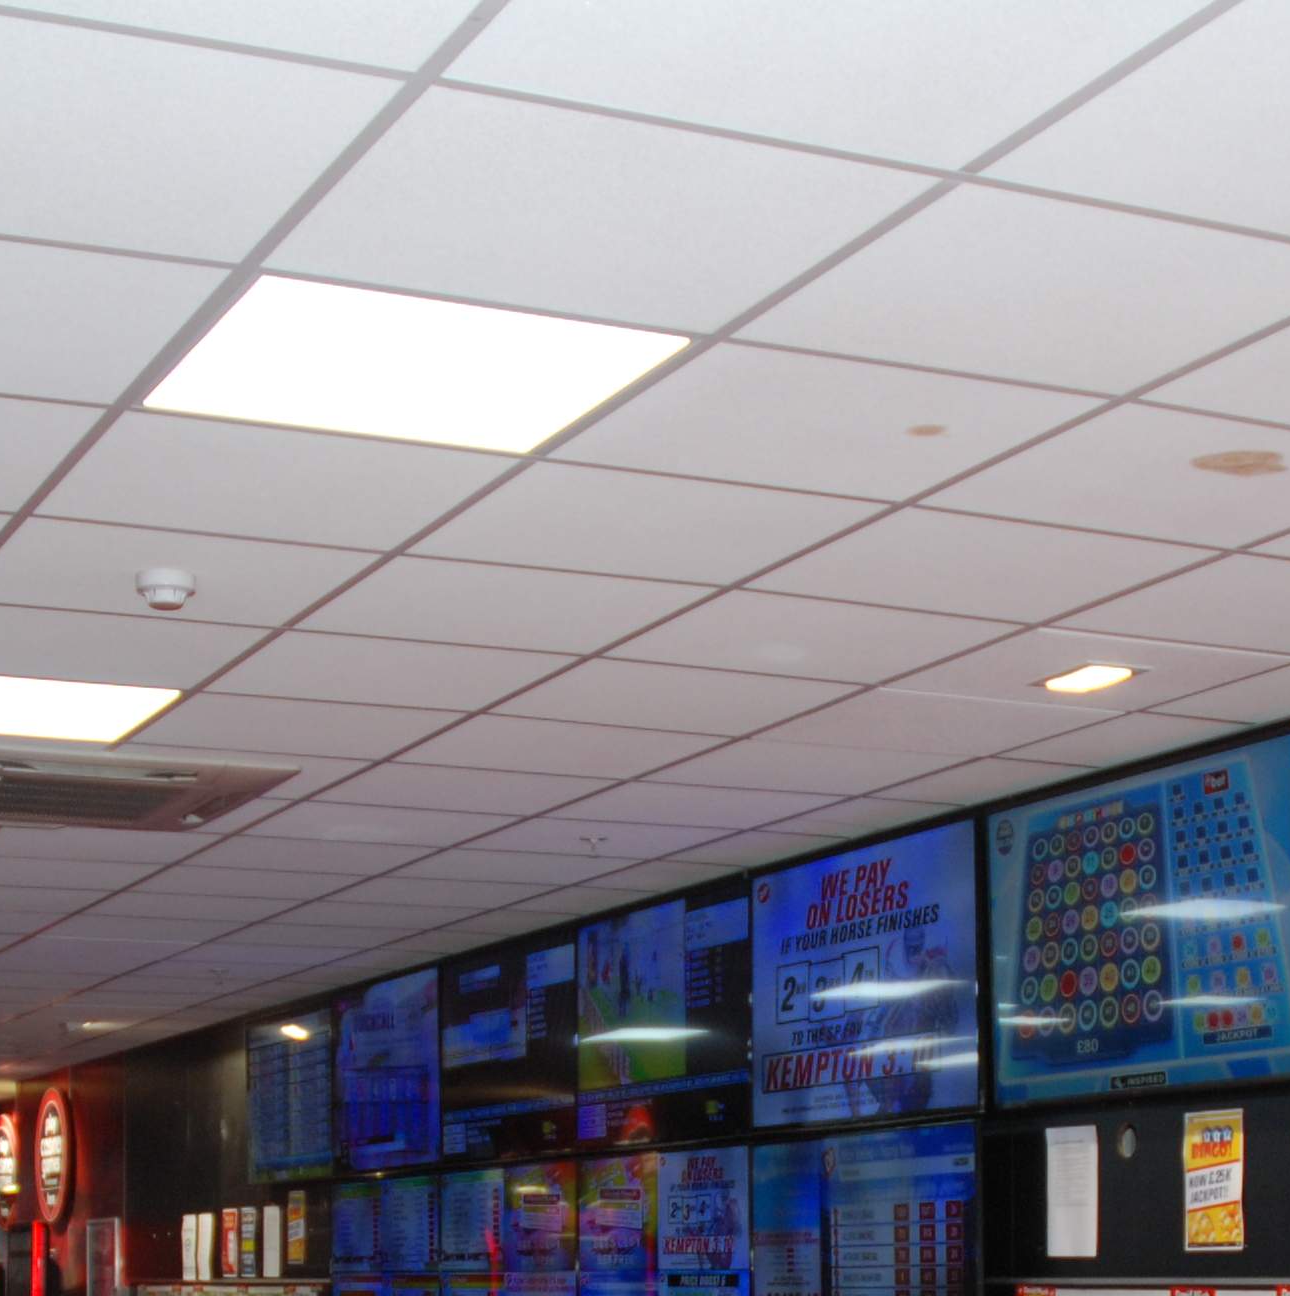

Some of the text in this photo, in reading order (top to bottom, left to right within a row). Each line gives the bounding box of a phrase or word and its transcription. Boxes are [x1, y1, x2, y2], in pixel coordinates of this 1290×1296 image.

[821, 857, 892, 900] WE PAY
[806, 881, 910, 930] ON LOSERS
[780, 904, 940, 955] IF YOUR HORSE FINISHES
[1218, 1029, 1259, 1042] JACKPOT
[1076, 1039, 1100, 1054] £80
[765, 1045, 874, 1091] KEMPTON
[1123, 1073, 1165, 1088] INSPIRED
[1191, 1140, 1233, 1160] BINGO!
[1189, 1173, 1207, 1189] NOW
[663, 1236, 710, 1255] KEMPTON
